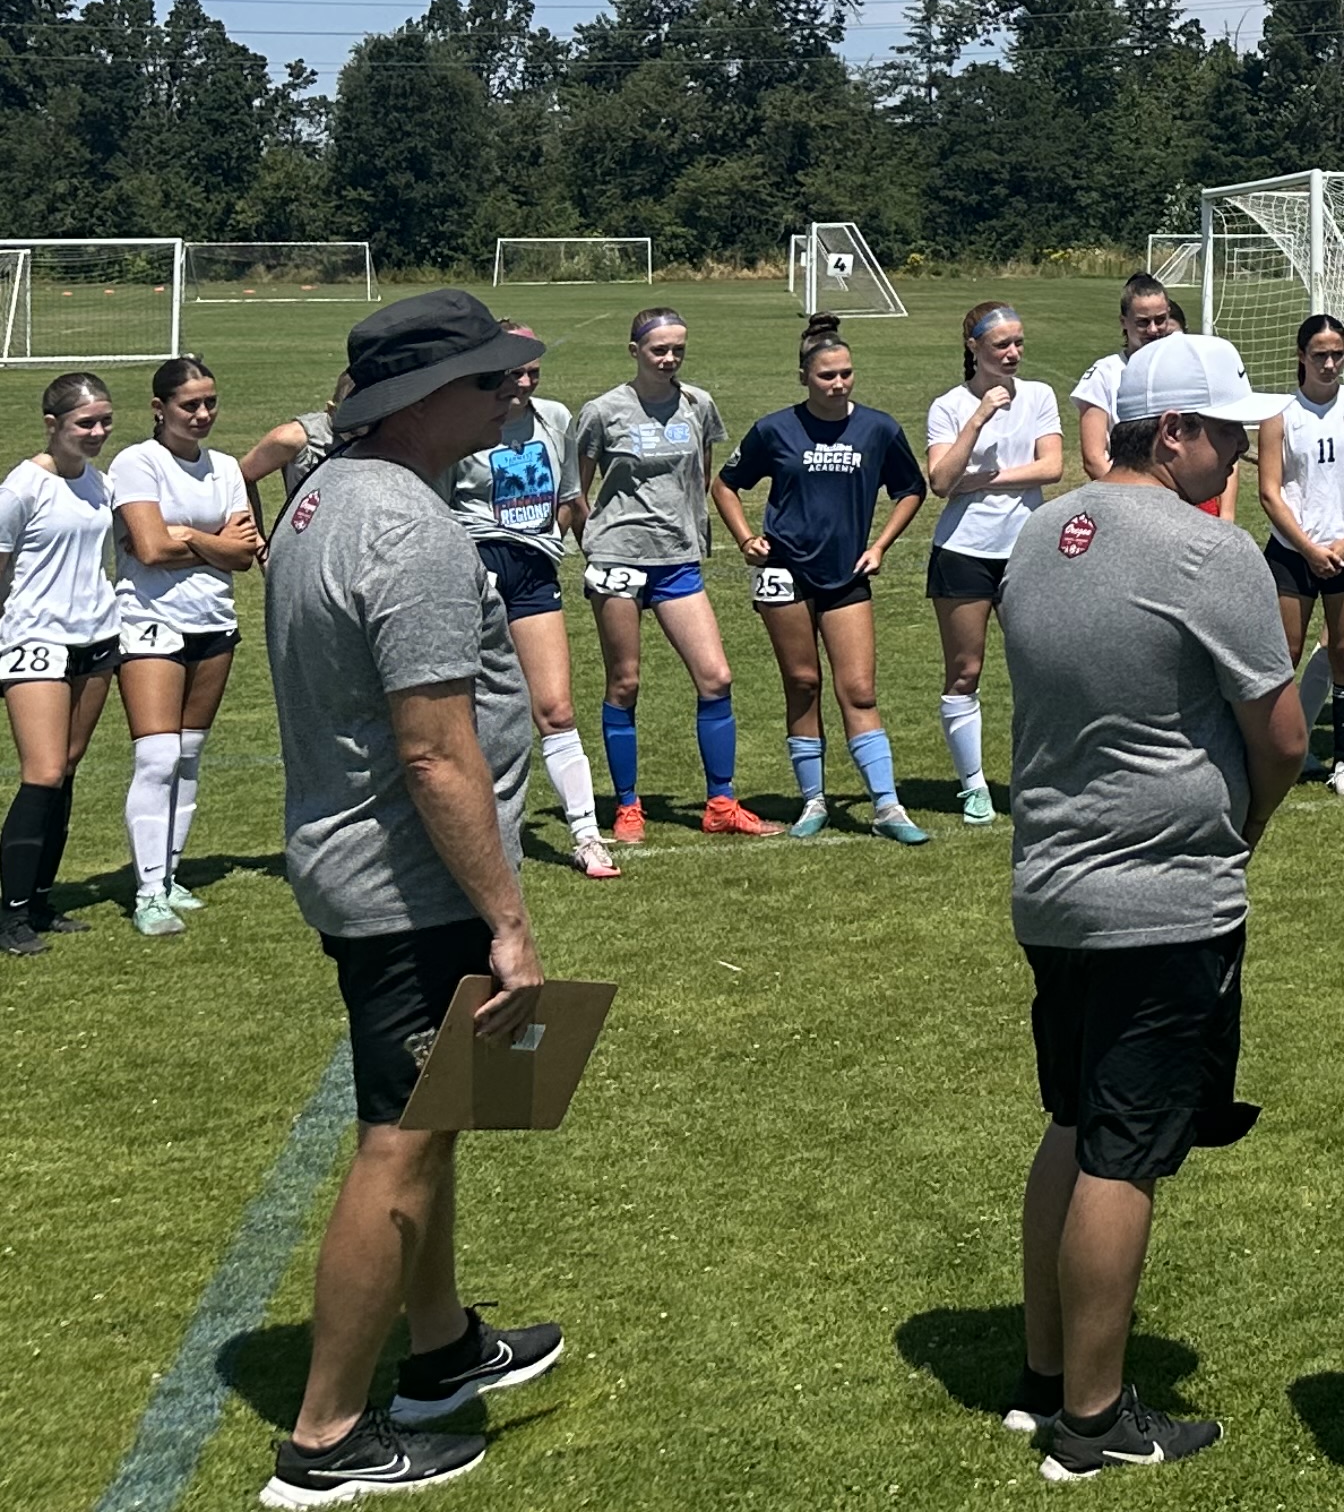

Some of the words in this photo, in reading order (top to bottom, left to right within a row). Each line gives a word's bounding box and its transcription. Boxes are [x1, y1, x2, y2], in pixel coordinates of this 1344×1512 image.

[833, 257, 847, 272] 4
[802, 450, 862, 468] SOCCER
[1317, 437, 1335, 464] 11
[808, 463, 855, 474] ACADEMY
[596, 567, 631, 592] 13
[756, 573, 781, 597] 25
[139, 623, 158, 647] 4
[9, 645, 50, 673] 28
